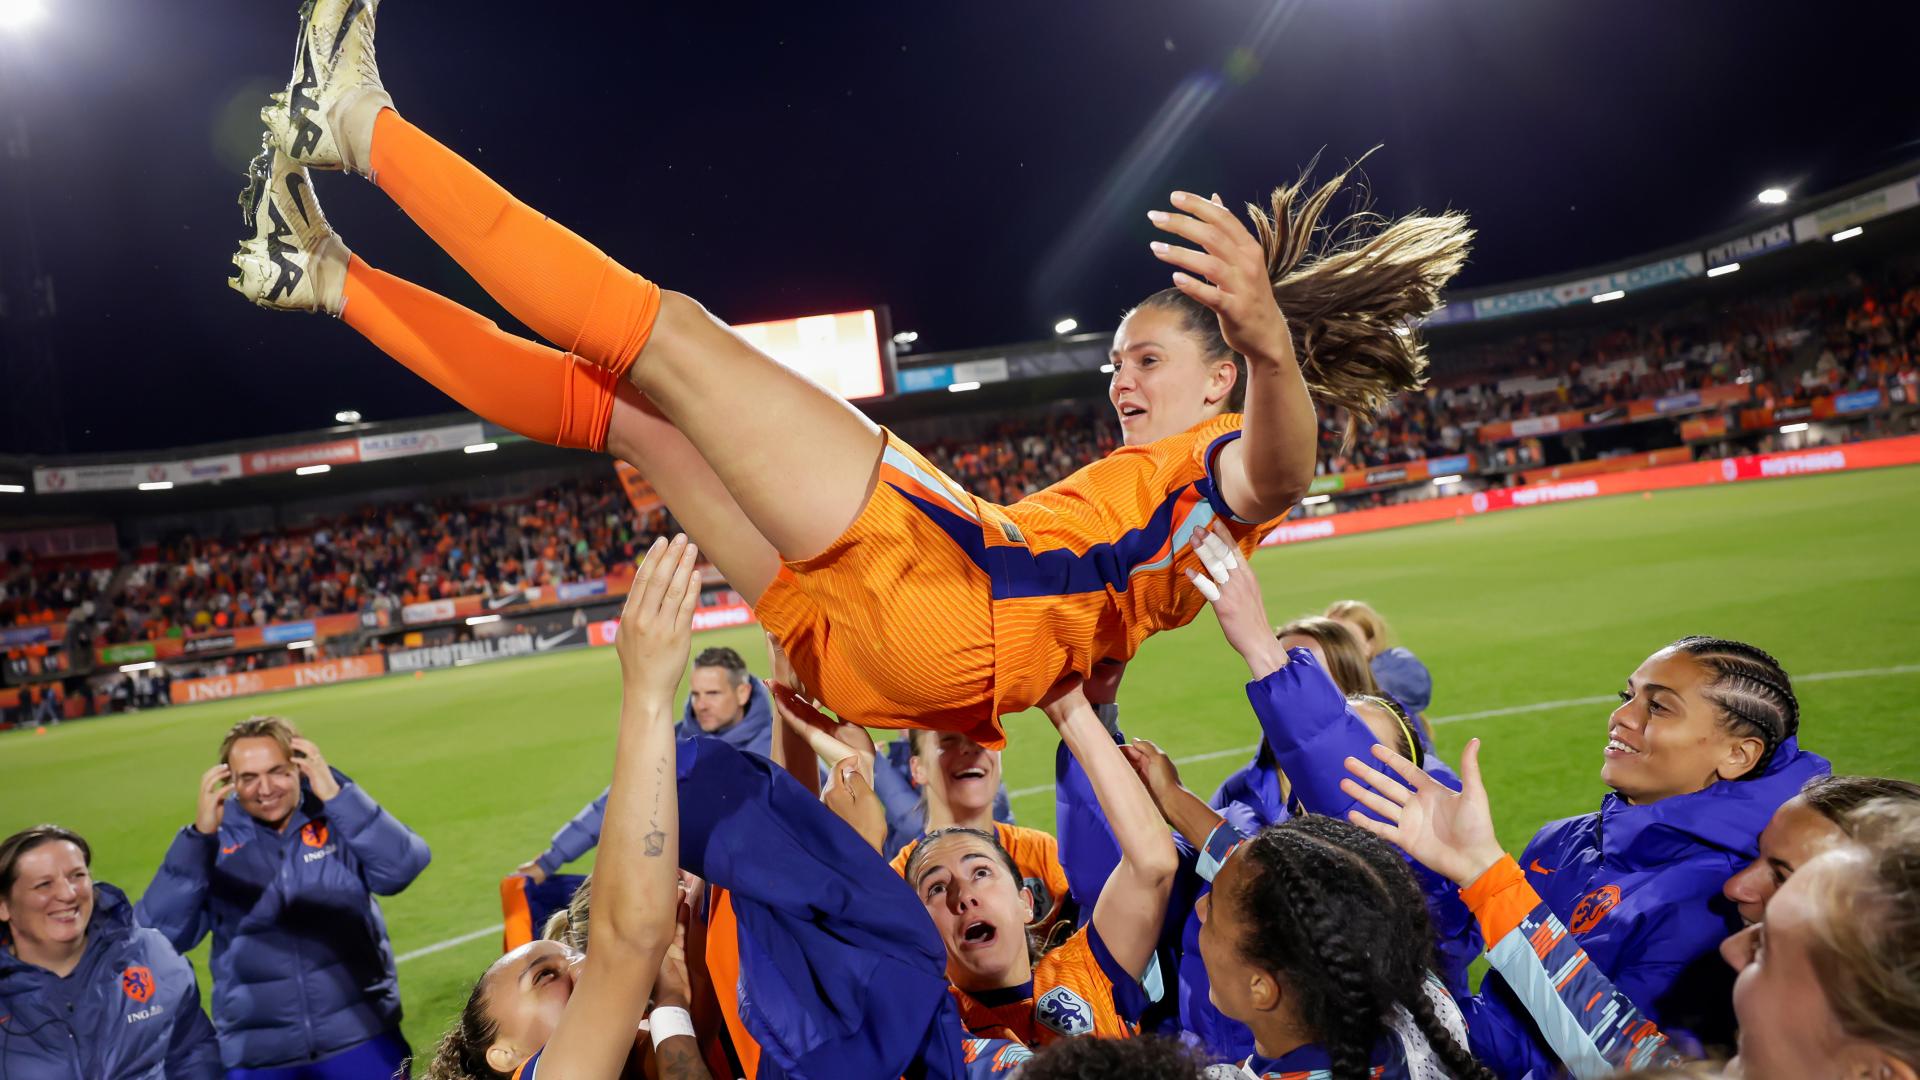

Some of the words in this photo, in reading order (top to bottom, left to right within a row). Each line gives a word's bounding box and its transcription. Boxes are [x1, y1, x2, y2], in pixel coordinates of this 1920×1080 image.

[295, 664, 337, 686] ING
[187, 681, 232, 701] ING
[303, 849, 325, 863] ING
[127, 1009, 150, 1024] ING
